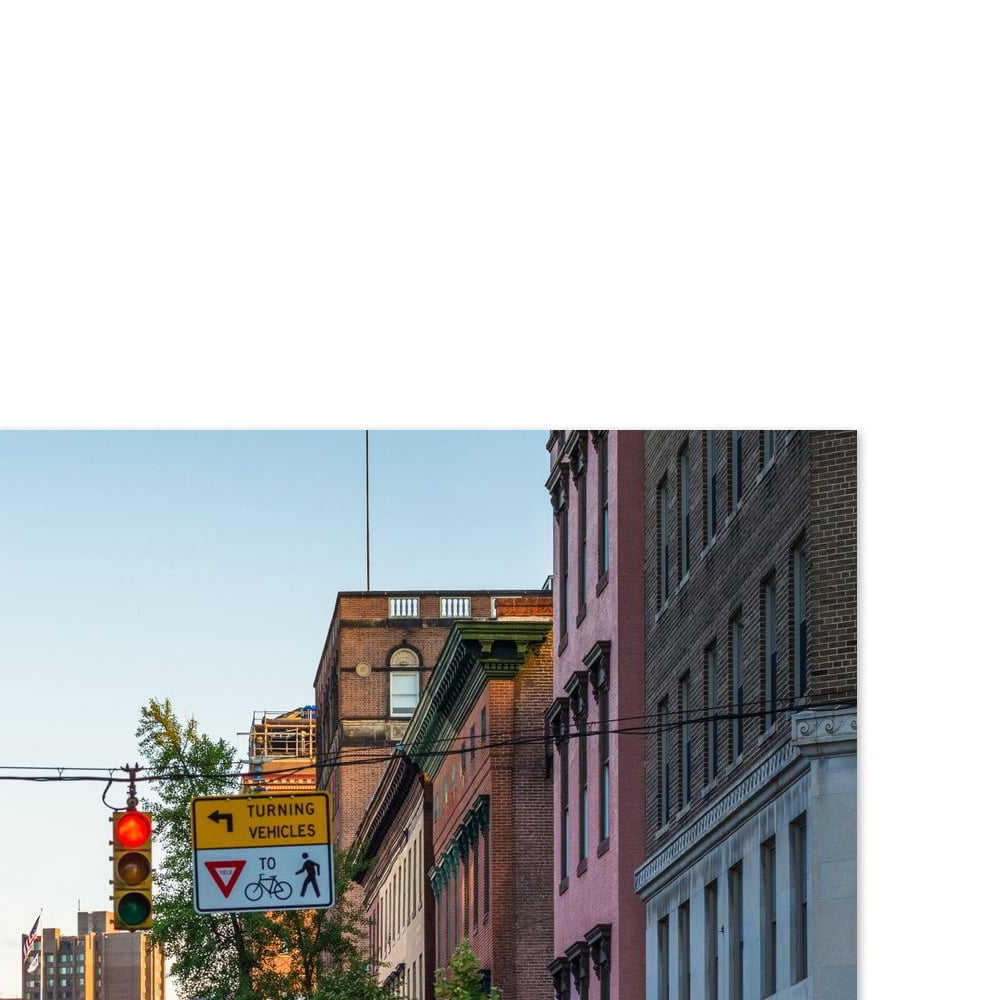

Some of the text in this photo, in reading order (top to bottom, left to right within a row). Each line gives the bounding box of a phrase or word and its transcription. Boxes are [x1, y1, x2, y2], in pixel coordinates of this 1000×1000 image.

[247, 802, 315, 818] TURNING
[248, 824, 316, 839] VEHICLES
[258, 857, 276, 870] TO
